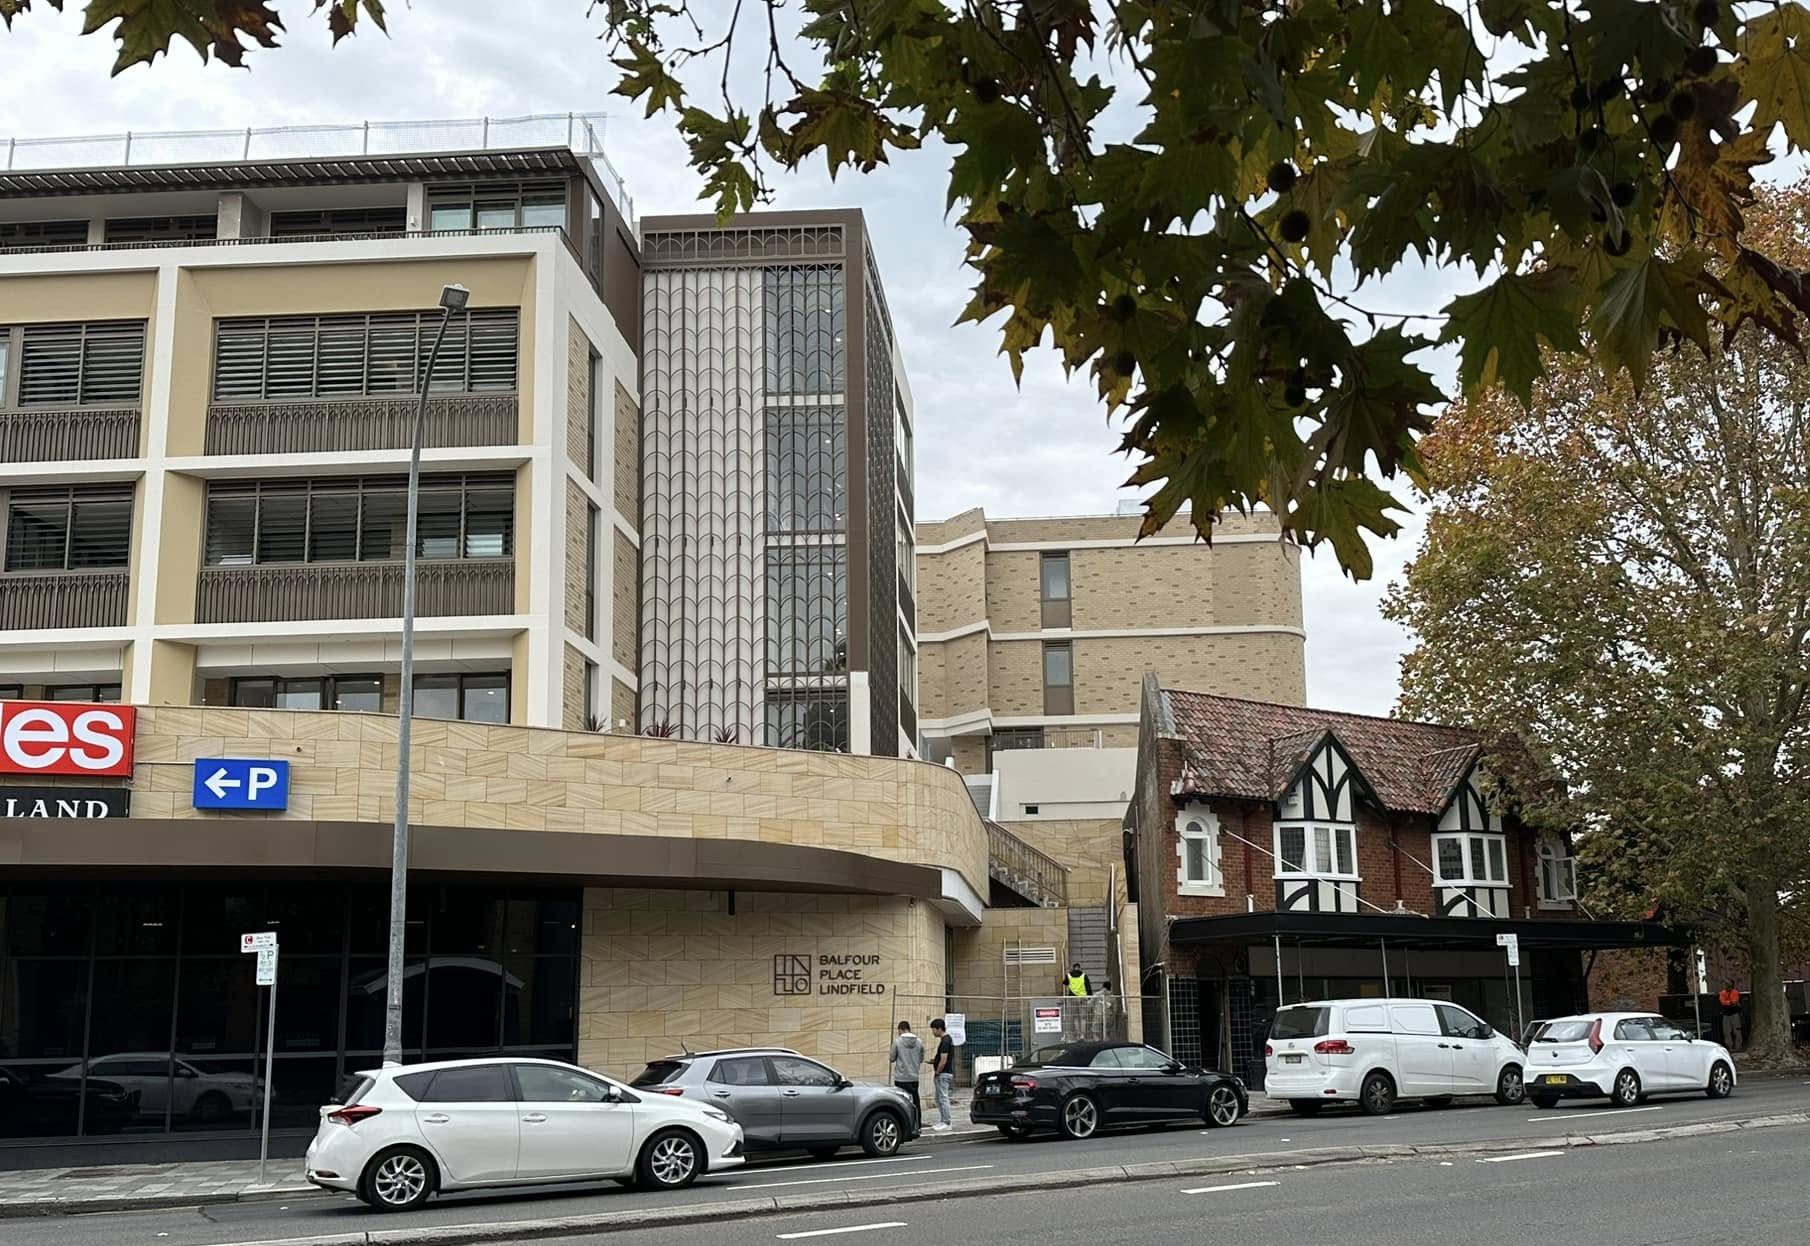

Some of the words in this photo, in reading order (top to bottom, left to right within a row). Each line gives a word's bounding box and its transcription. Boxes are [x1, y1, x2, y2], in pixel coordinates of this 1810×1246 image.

[0, 702, 124, 770] es
[248, 767, 278, 801] P
[5, 798, 109, 819] LAND
[819, 954, 880, 966] BALFOUR
[819, 969, 862, 980] PLACE
[819, 984, 885, 995] LINDFIELD
